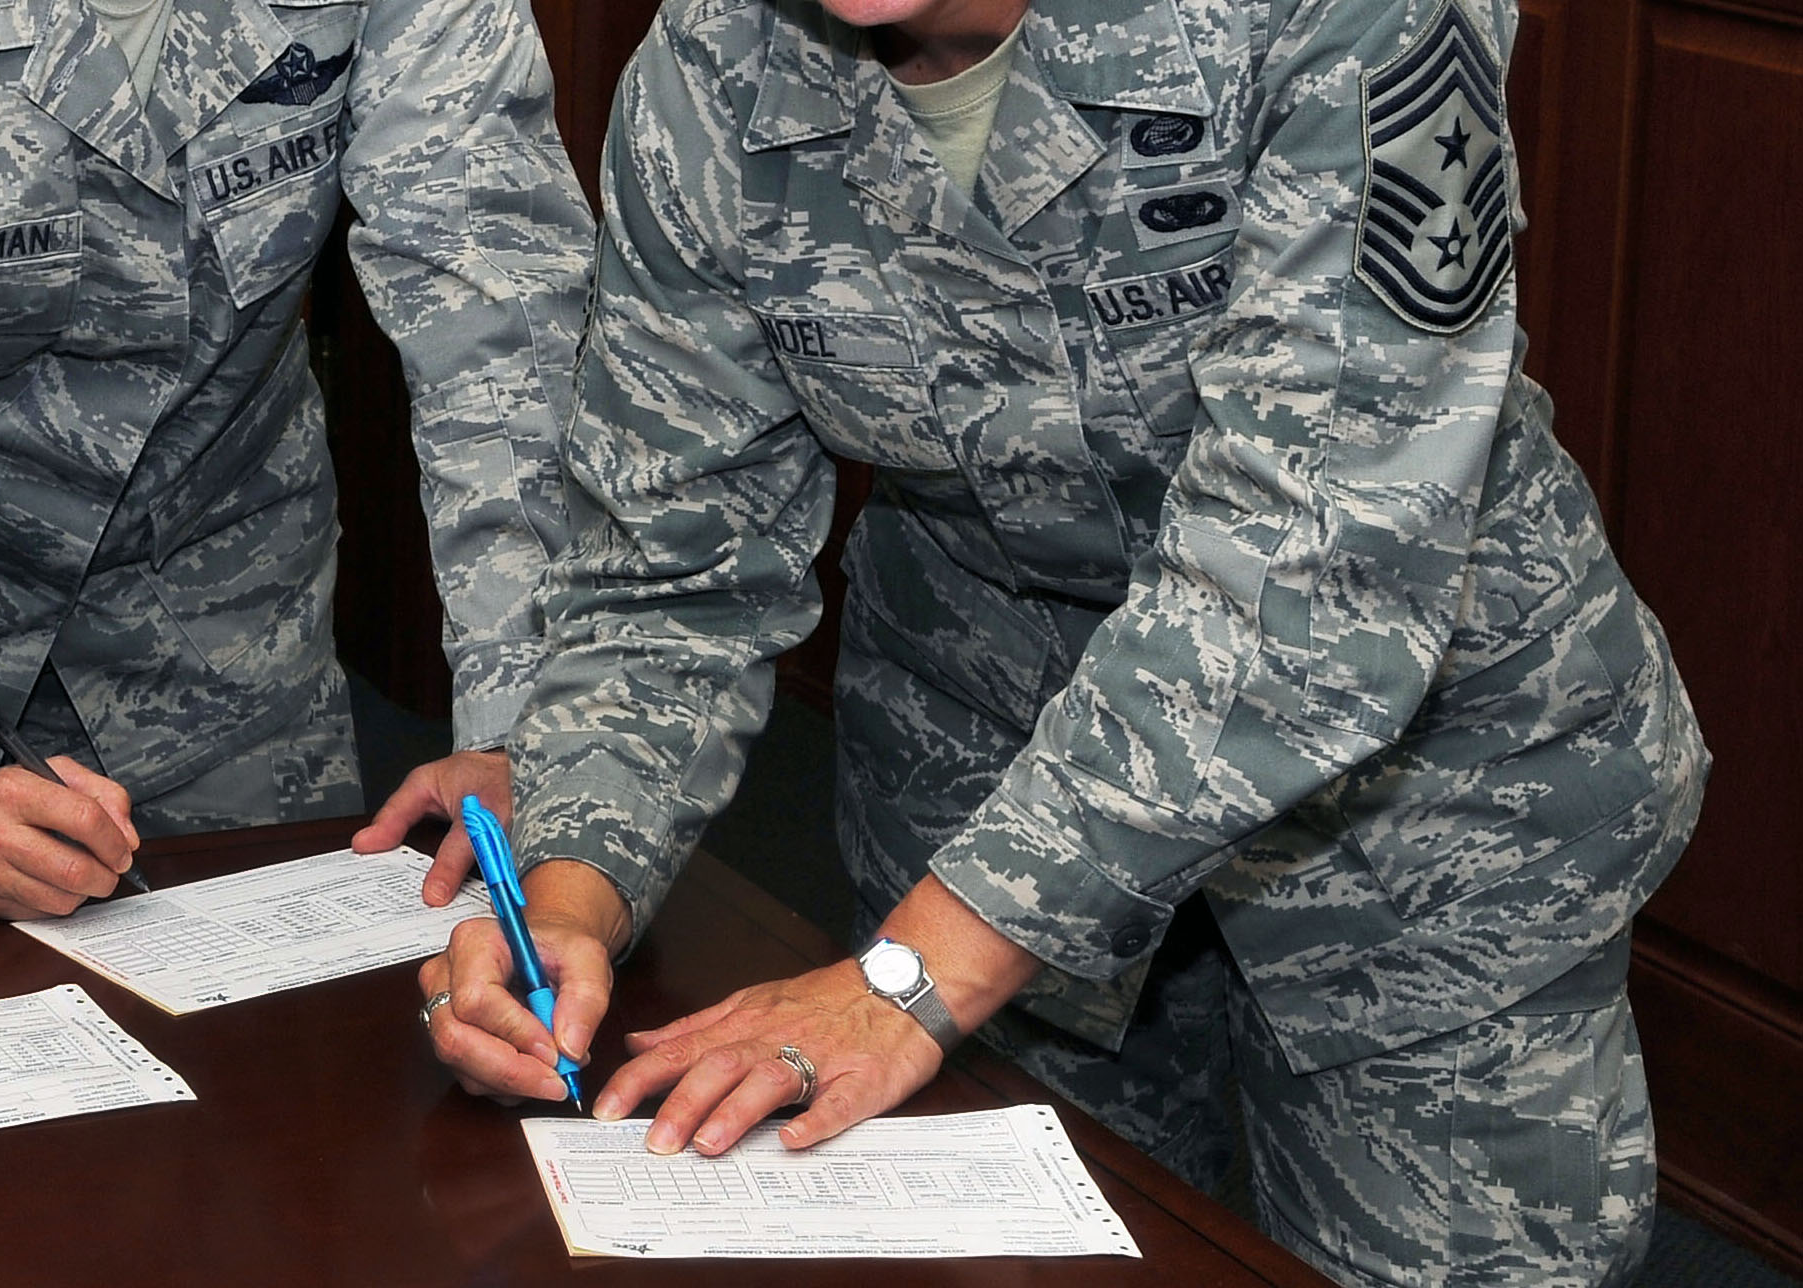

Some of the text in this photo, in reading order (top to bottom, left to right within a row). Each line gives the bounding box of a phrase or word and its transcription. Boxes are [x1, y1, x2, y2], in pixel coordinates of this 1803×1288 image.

[206, 158, 261, 201] U.S.
[268, 136, 322, 180] AIR
[1091, 262, 1233, 327] U.S. AIR
[757, 314, 836, 357] NOEL
